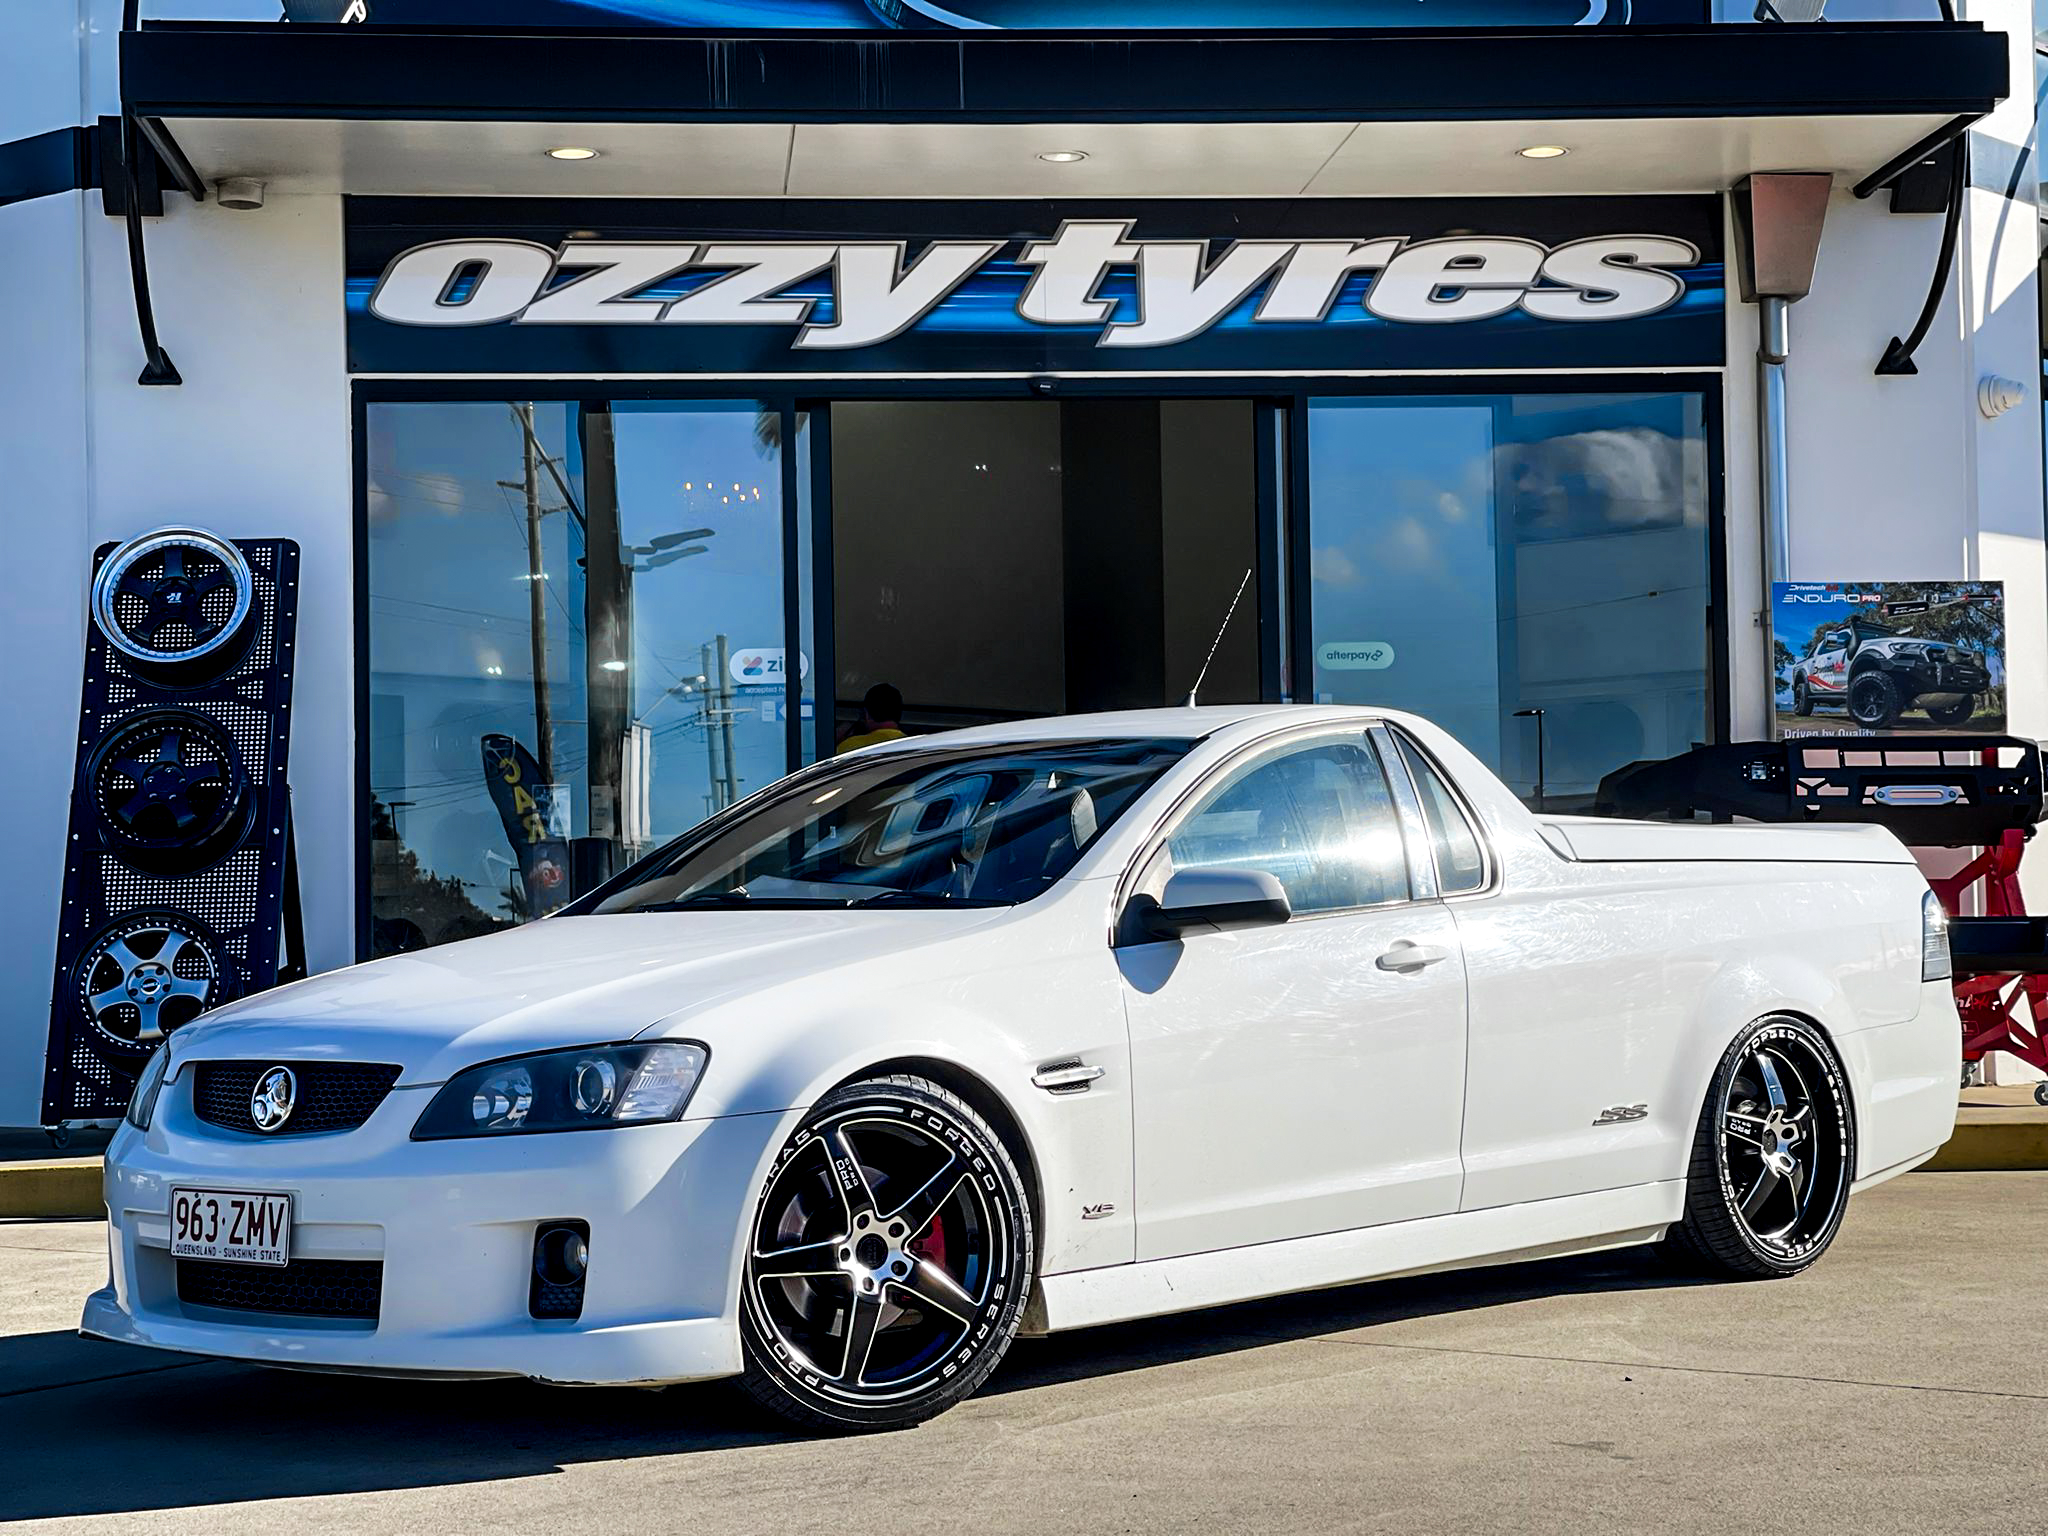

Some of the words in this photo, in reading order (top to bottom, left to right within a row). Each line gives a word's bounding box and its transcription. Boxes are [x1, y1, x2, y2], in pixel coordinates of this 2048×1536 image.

[369, 237, 1010, 351] ozzy
[1015, 218, 1702, 349] tyres
[1782, 594, 1861, 603] ENDURO
[1862, 594, 1882, 603] PRO
[1326, 651, 1371, 661] afterpay
[1784, 728, 1819, 739] Driven
[1838, 728, 1876, 737] Quality
[910, 1108, 997, 1192] FORGED
[835, 1159, 854, 1191] PRO
[175, 1243, 217, 1257] QUEENSLAND
[223, 1247, 257, 1259] SUNSHINE
[260, 1249, 281, 1262] STATE
[942, 1283, 1006, 1379] SERIES
[773, 1342, 820, 1387] PRO
